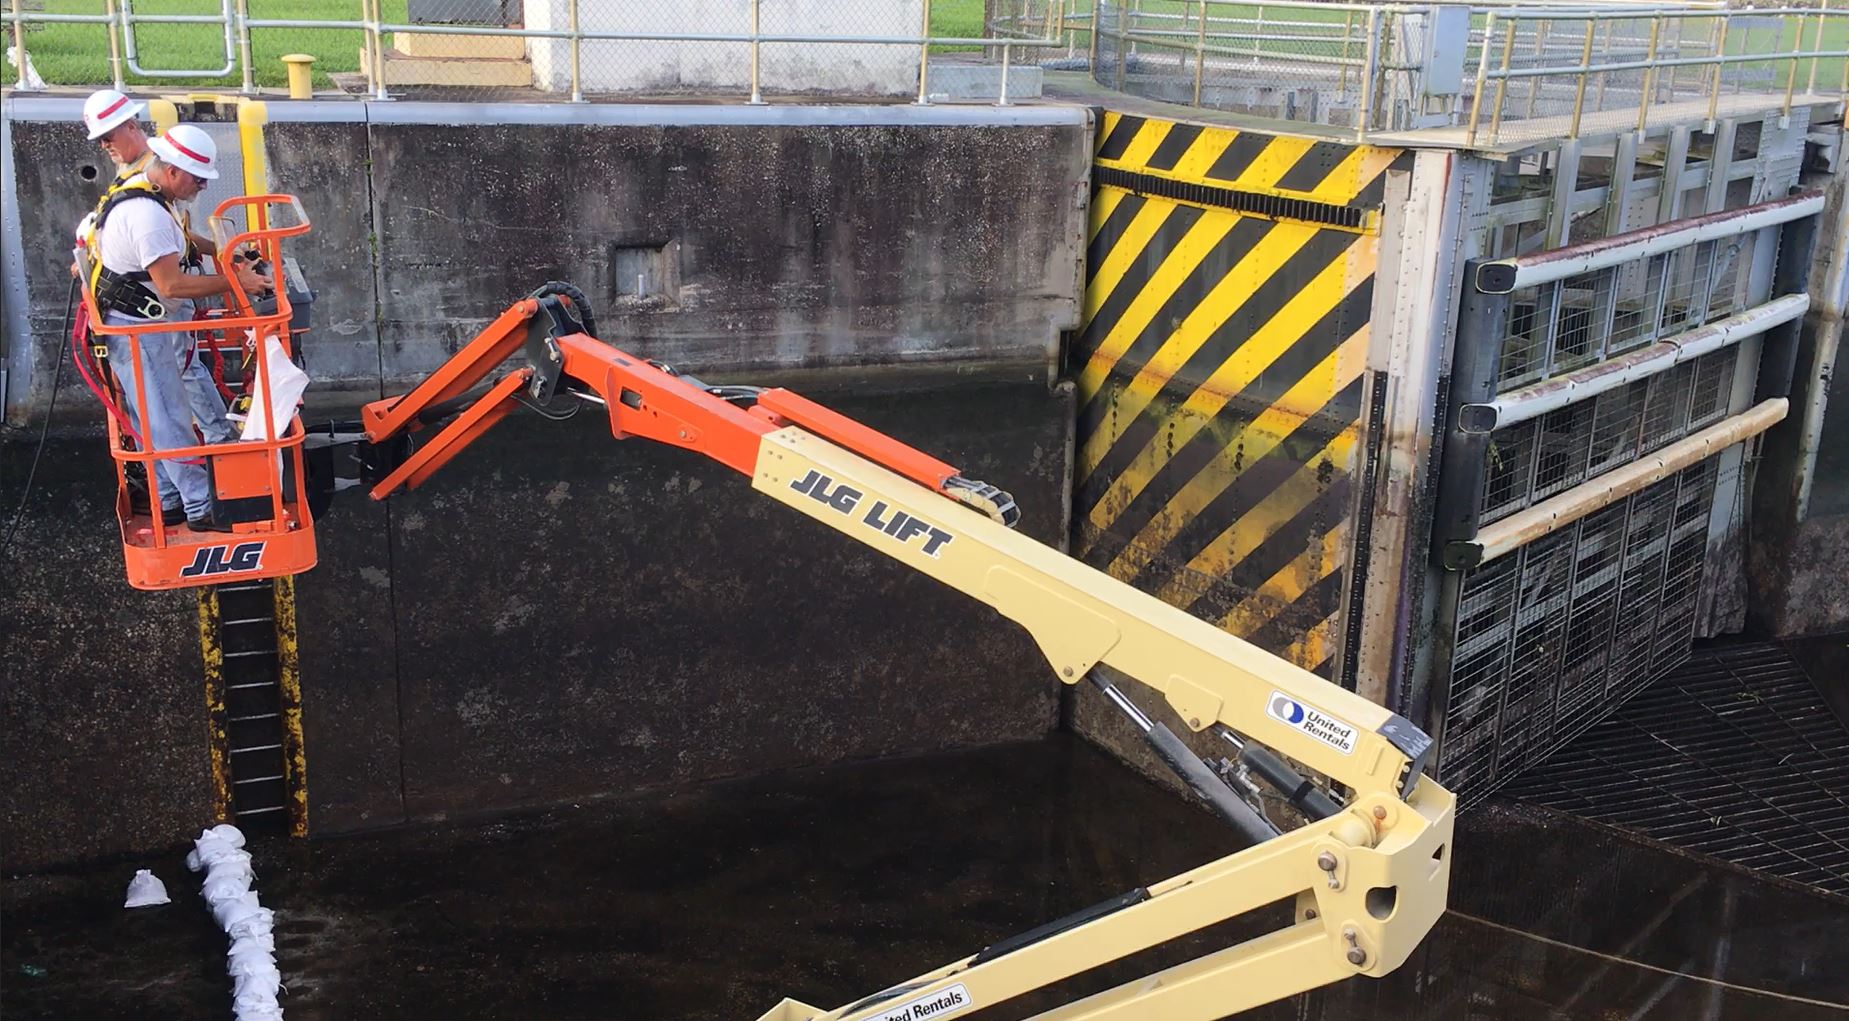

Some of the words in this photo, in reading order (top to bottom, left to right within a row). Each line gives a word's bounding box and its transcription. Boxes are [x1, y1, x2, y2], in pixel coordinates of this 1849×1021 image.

[790, 469, 863, 515] JLG
[863, 500, 953, 556] LIFT
[180, 541, 266, 577] JLG
[1303, 721, 1350, 750] Rentals
[1308, 711, 1351, 738] United
[913, 992, 963, 1018] Rentals
